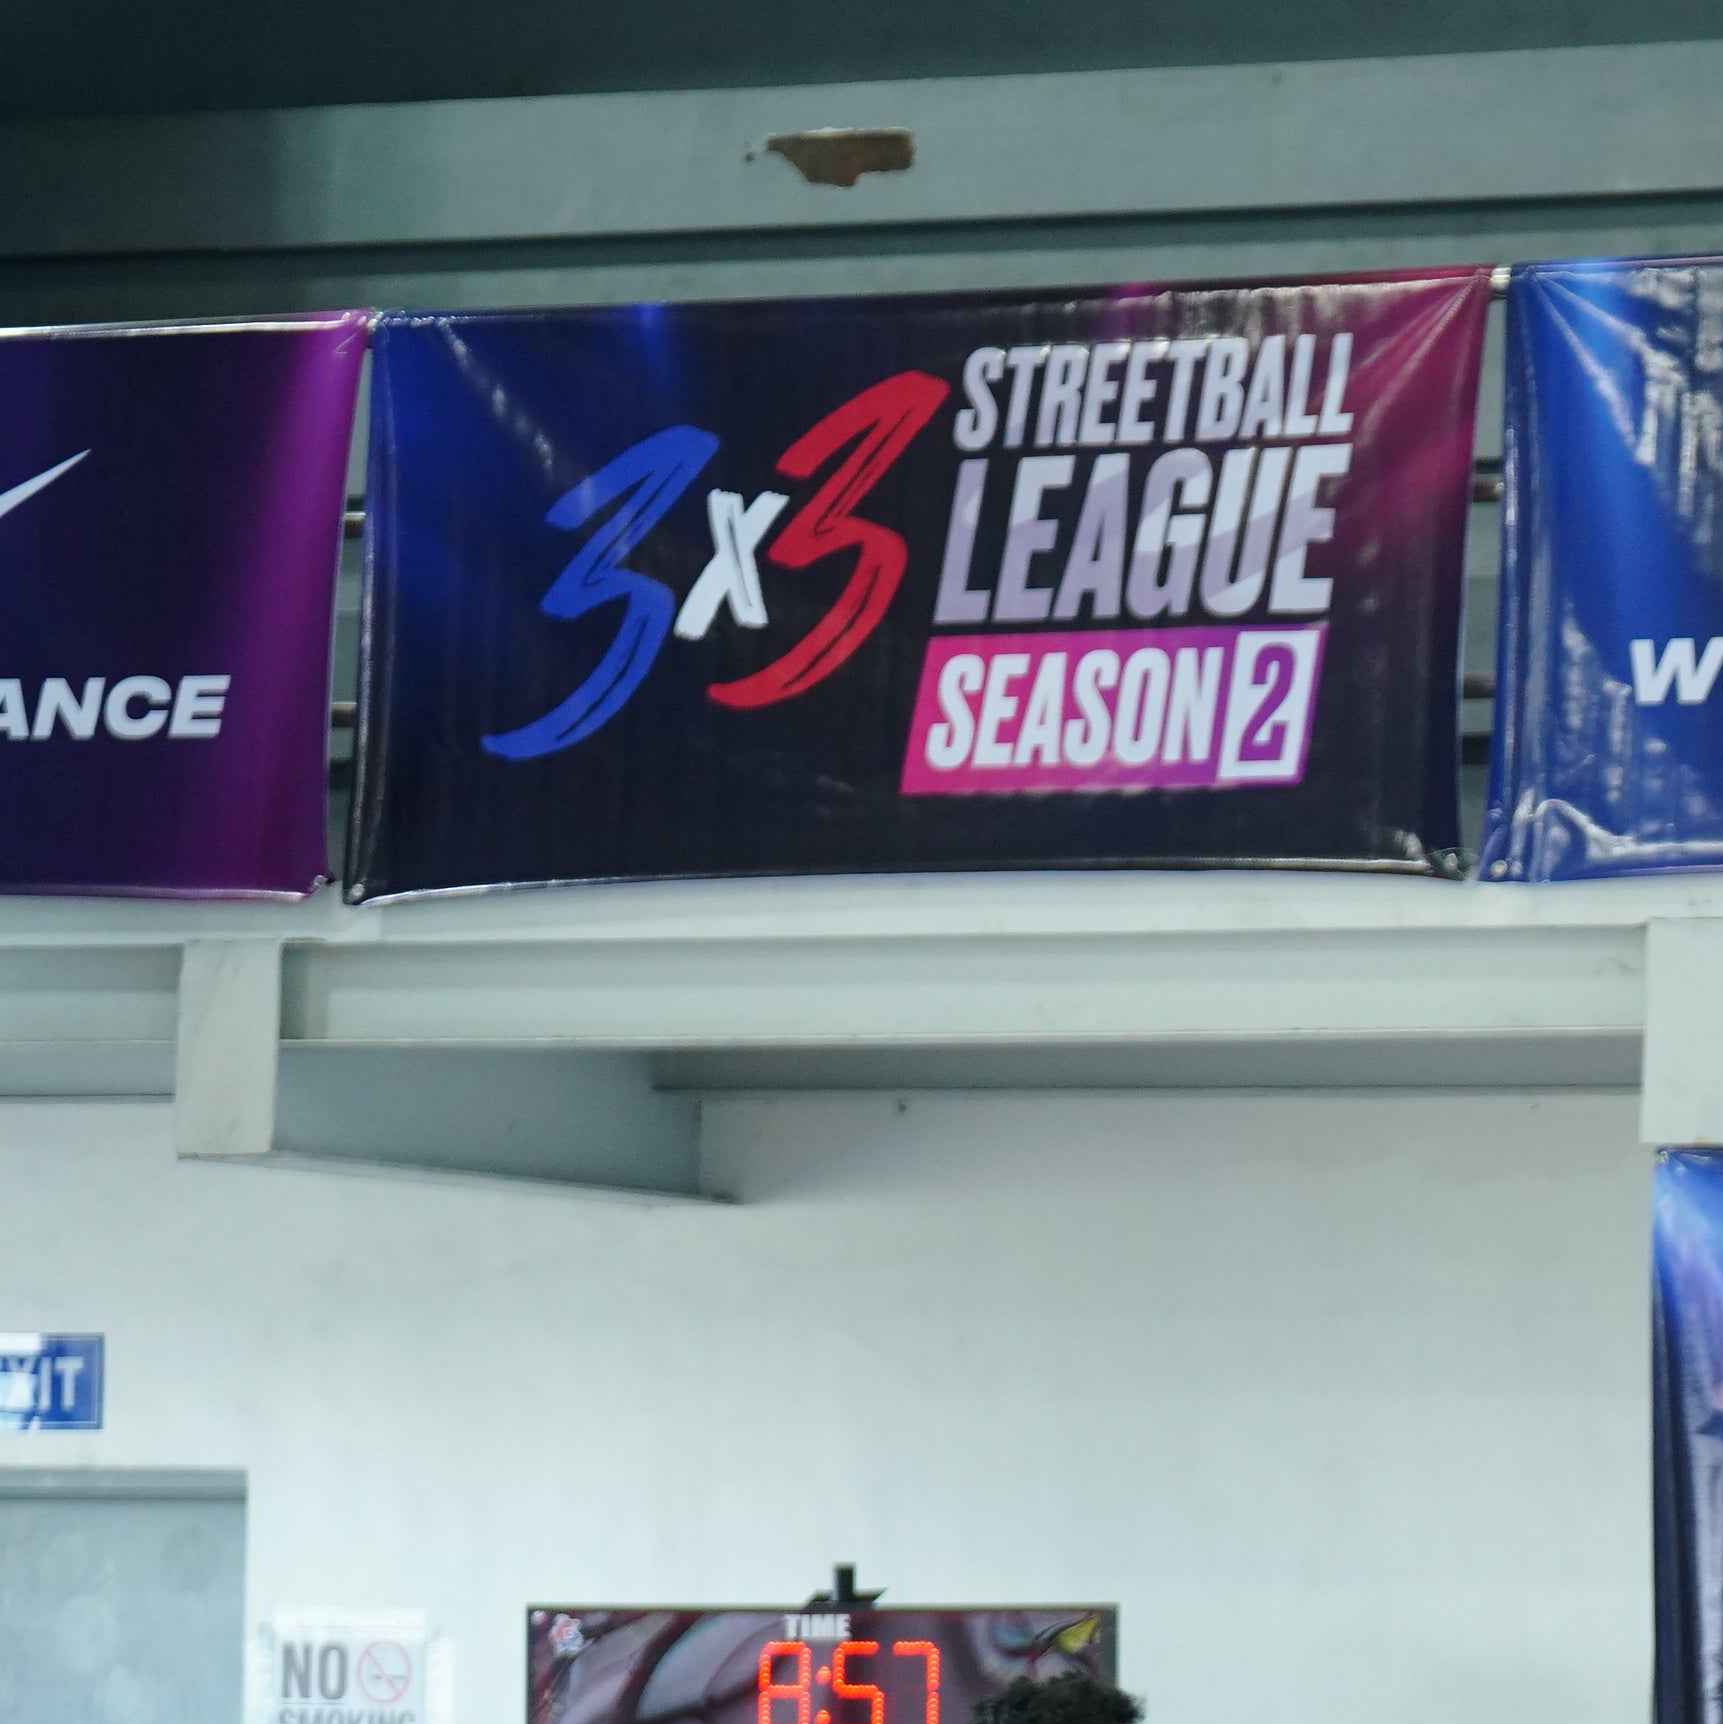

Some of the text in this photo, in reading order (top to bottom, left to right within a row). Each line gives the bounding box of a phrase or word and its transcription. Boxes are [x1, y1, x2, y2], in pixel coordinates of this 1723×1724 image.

[954, 333, 1354, 451] STREETBALL
[934, 443, 1353, 625] LEAGUE
[925, 641, 1294, 771] SEASON 2
[281, 1640, 348, 1700] NO
[784, 1614, 852, 1640] TIME
